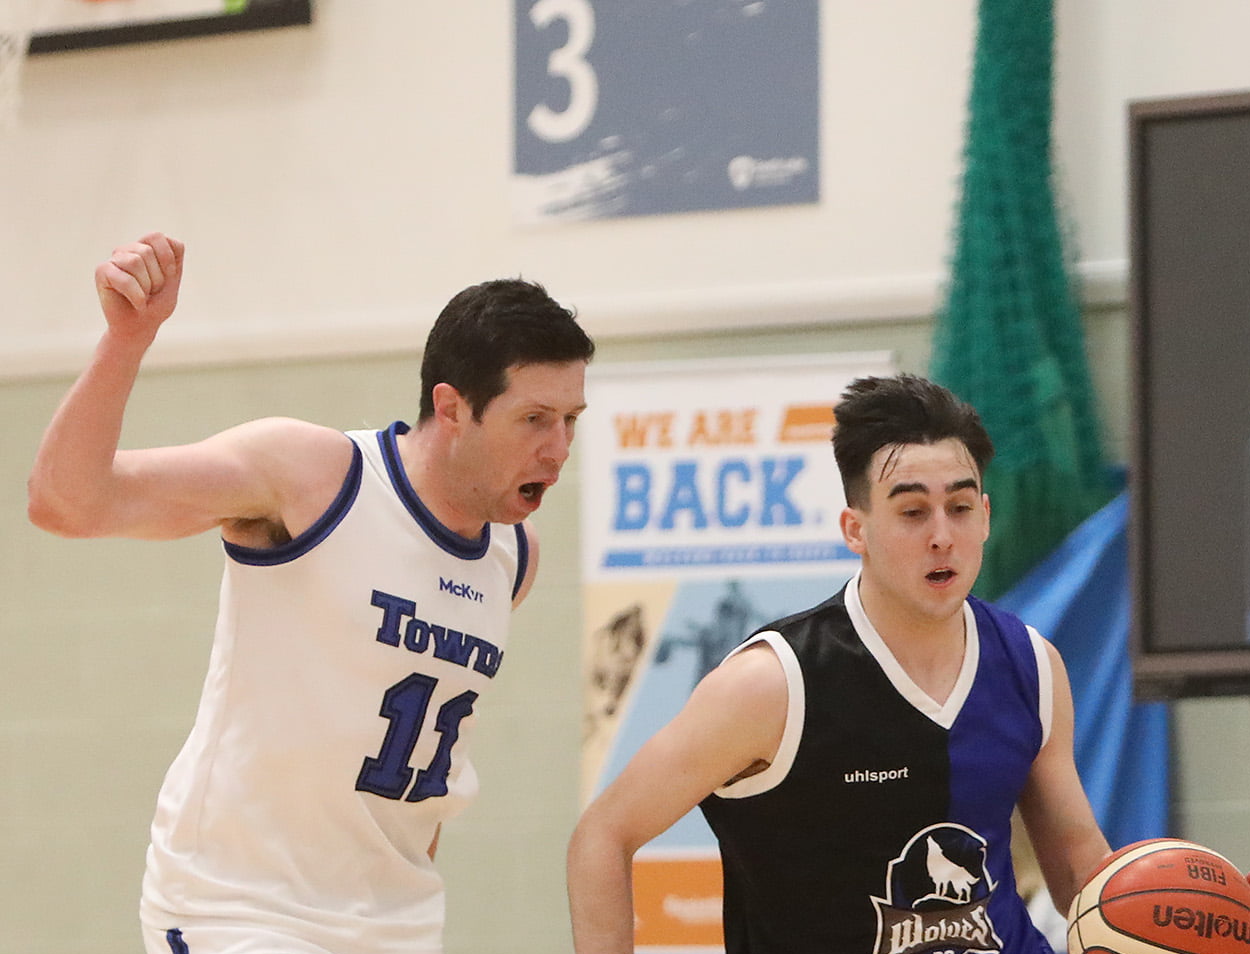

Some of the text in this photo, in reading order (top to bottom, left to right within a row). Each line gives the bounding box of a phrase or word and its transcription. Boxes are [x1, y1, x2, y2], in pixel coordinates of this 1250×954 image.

[527, 0, 599, 144] 3
[612, 412, 676, 449] WE
[687, 408, 759, 446] ARE
[355, 672, 479, 802] 11
[844, 766, 909, 783] uhlsport
[1186, 864, 1227, 886] FIBA
